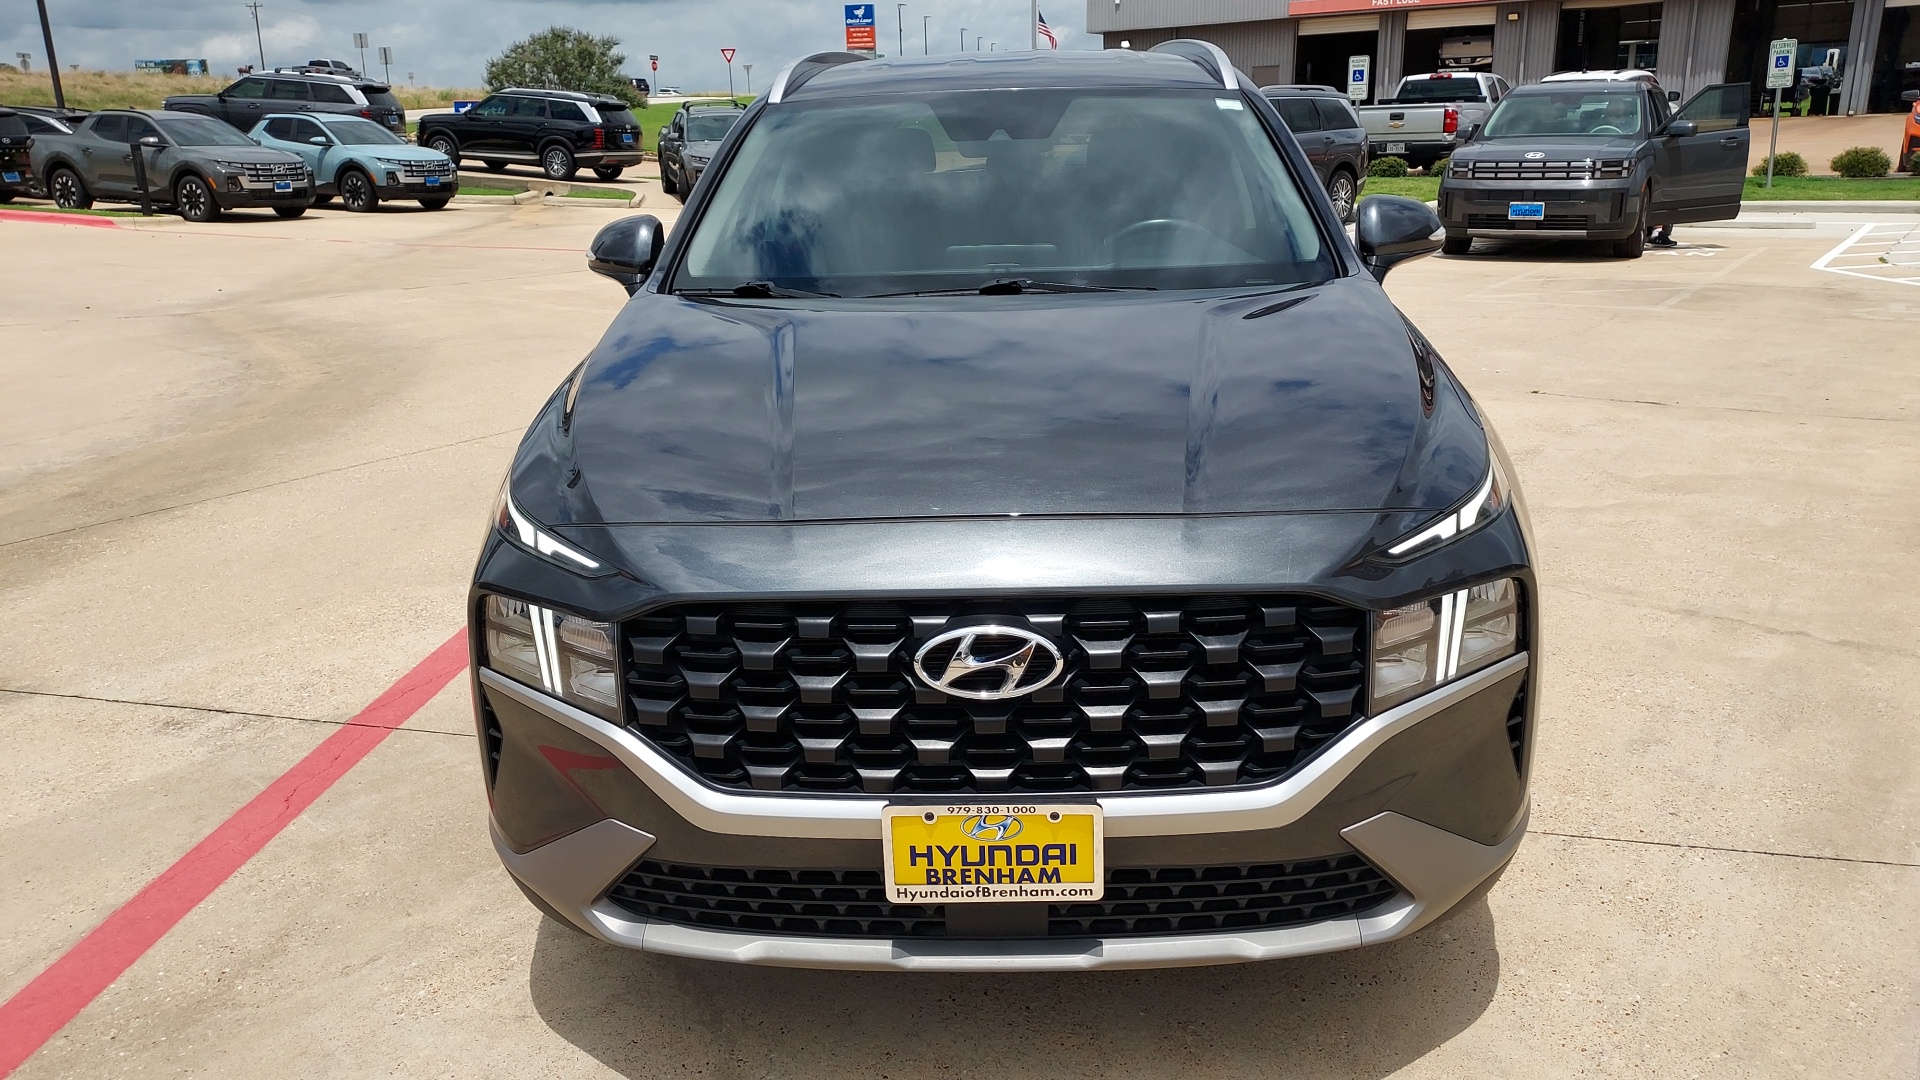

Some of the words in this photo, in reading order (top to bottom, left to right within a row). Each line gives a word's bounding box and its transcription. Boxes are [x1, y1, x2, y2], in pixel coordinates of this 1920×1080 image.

[947, 806, 1036, 814] 979-830-1000
[909, 843, 1077, 867] HYUNDAI
[926, 867, 1062, 885] BRENHAM
[896, 886, 1094, 902] HyundaiofBrenham.com
